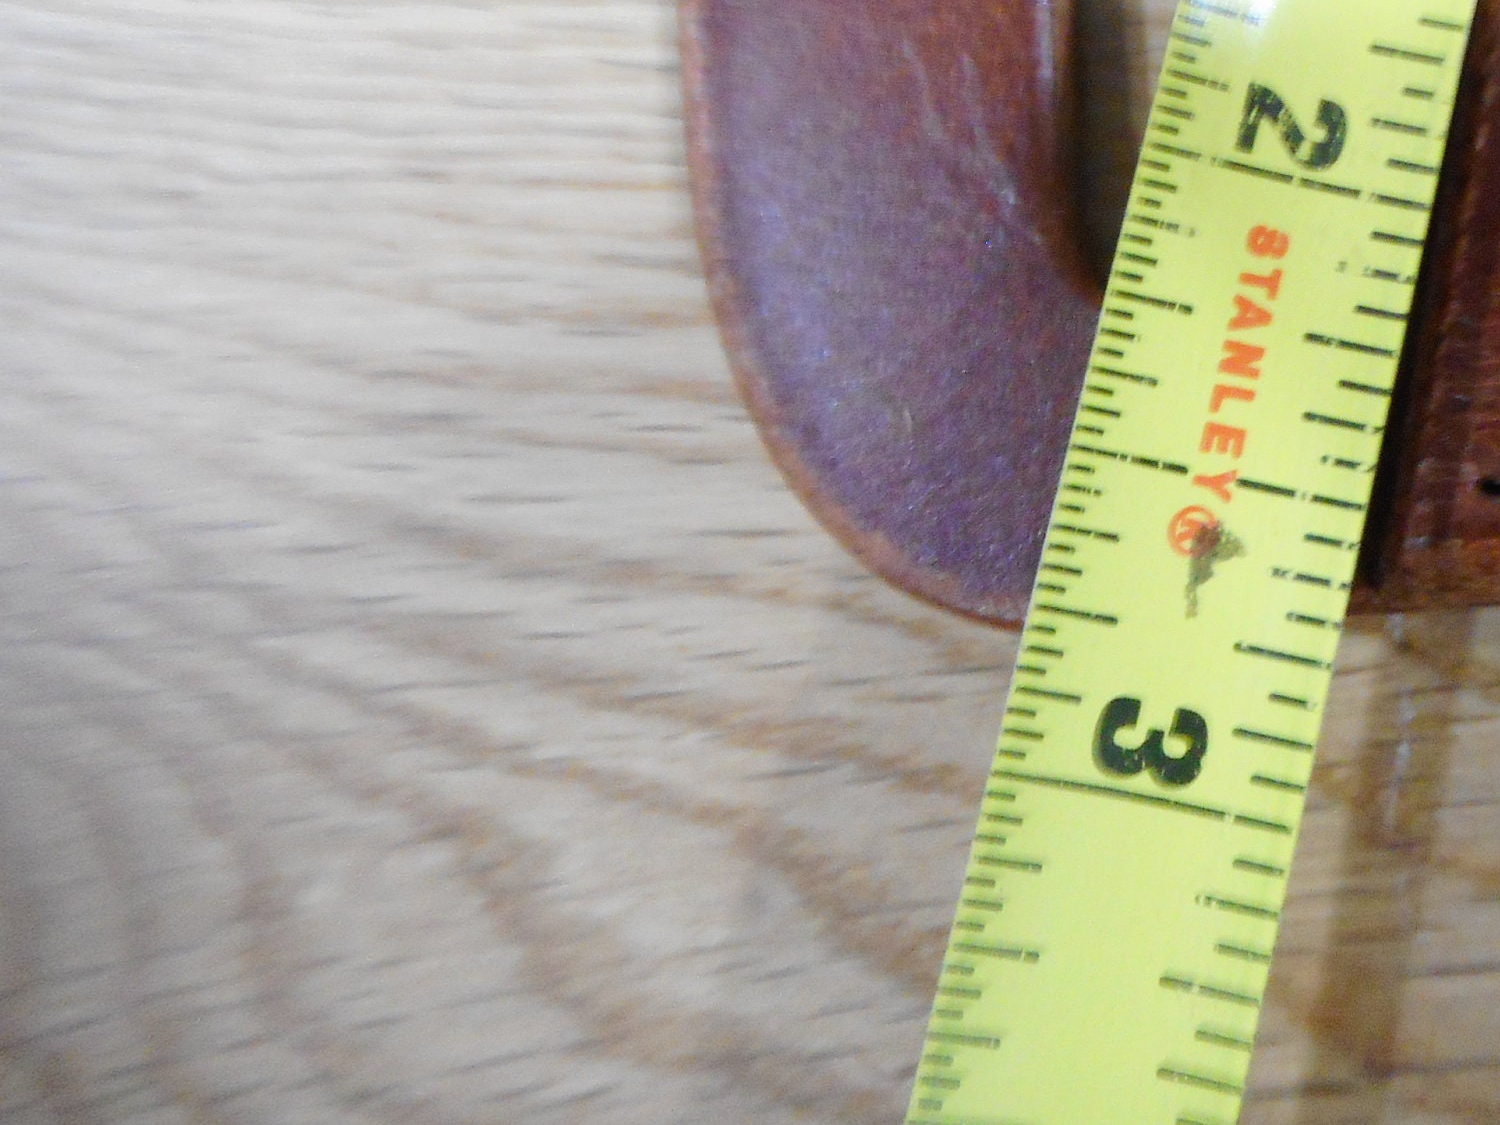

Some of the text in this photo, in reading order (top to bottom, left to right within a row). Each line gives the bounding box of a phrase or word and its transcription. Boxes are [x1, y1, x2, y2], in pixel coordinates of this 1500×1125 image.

[1234, 80, 1348, 172] 2
[1191, 224, 1290, 503] STANLEY
[1091, 693, 1209, 790] 3
